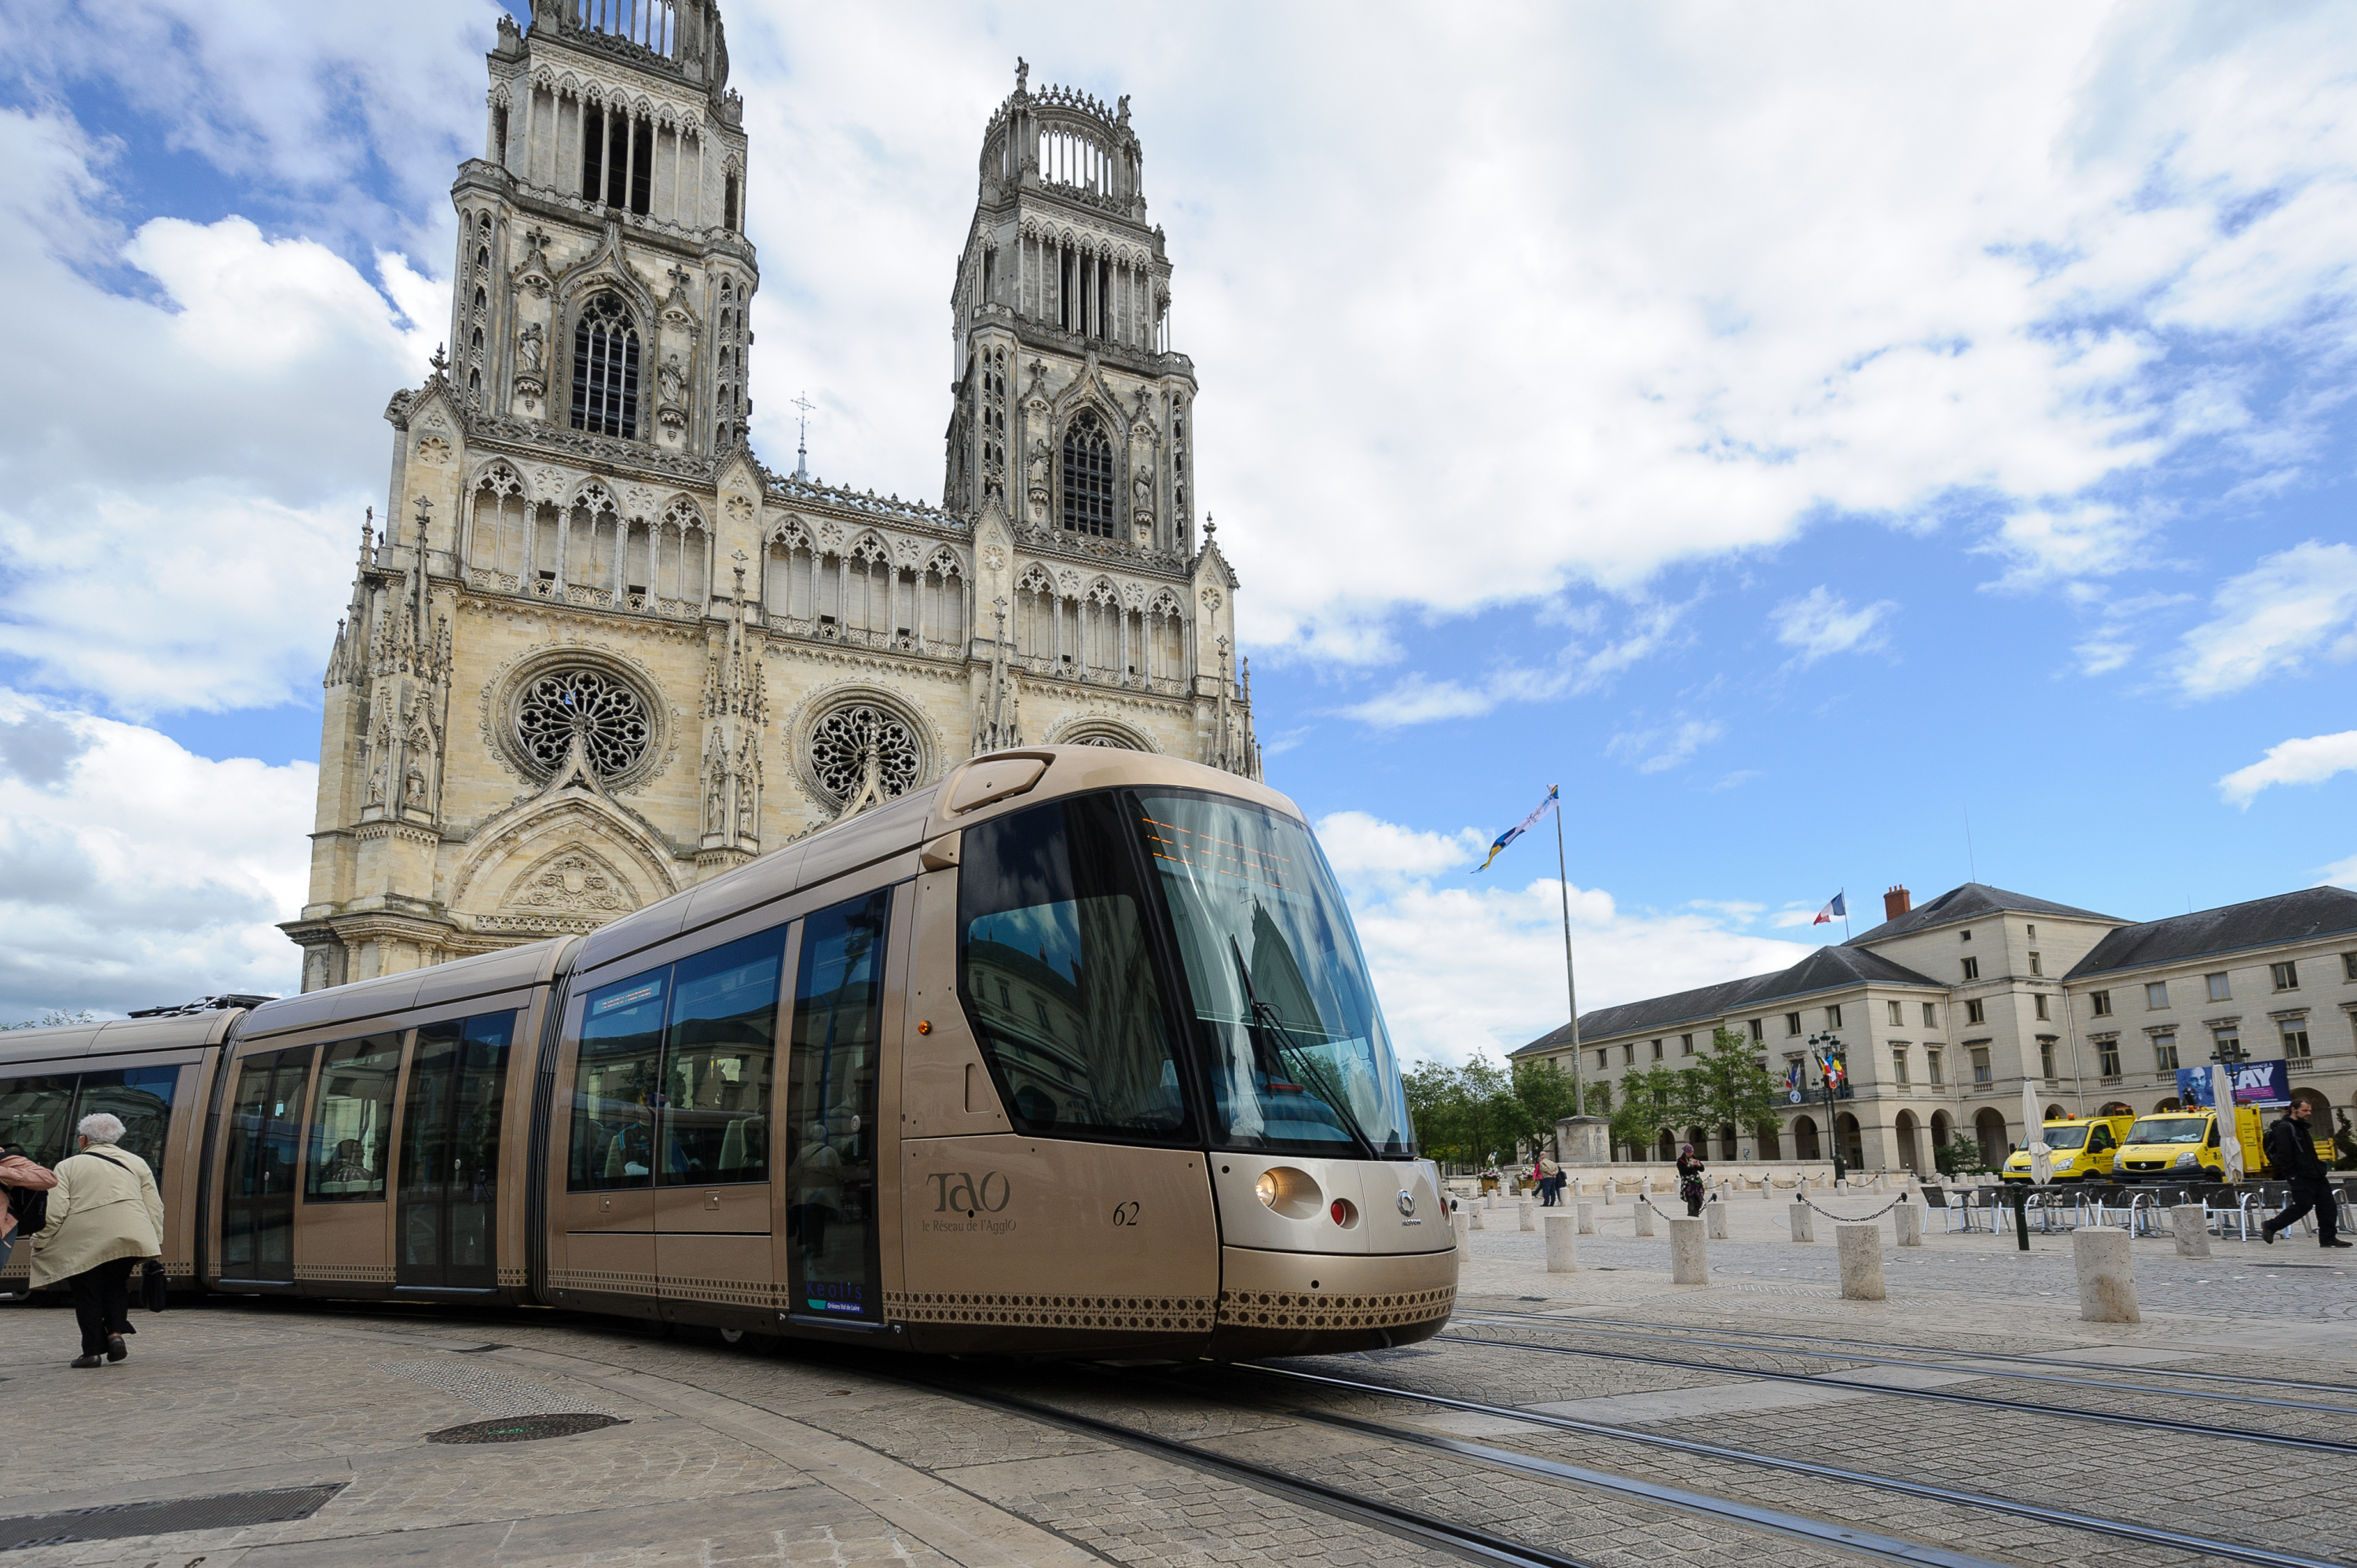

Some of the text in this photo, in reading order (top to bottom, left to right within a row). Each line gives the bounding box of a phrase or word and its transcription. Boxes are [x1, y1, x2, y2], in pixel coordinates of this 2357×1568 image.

[1113, 1201, 1140, 1226] 62
[922, 1219, 930, 1232] le
[933, 1219, 964, 1232] Réseau
[966, 1219, 977, 1232] de
[806, 1280, 863, 1300] Keolis
